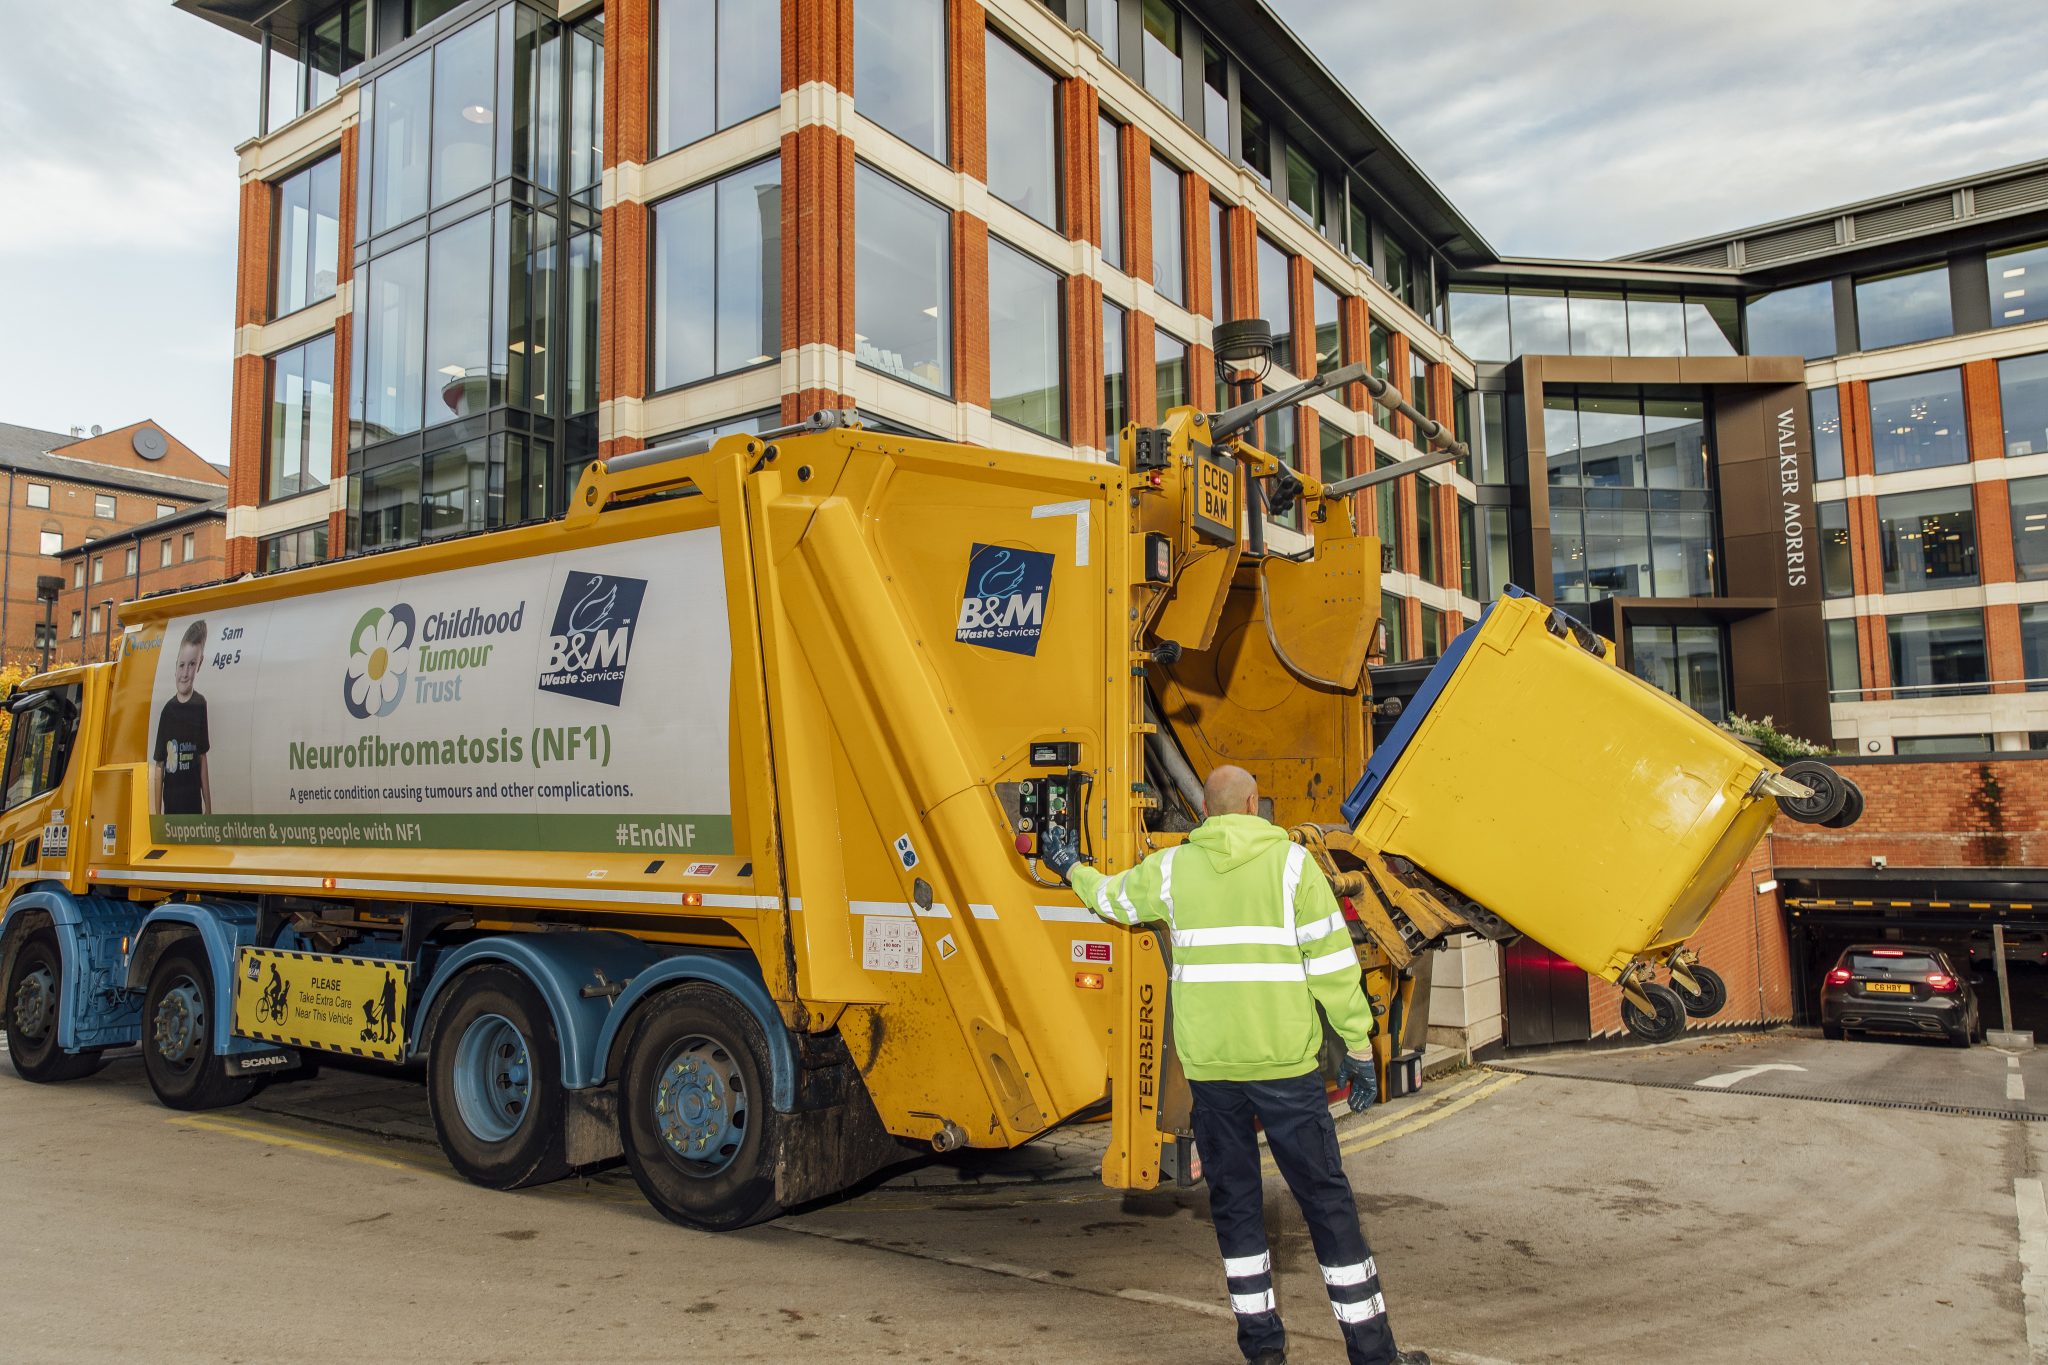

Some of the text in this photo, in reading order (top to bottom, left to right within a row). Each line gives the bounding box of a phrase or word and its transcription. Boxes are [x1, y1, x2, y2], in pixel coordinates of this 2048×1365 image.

[1203, 463, 1229, 496] CC19
[1205, 491, 1228, 521] BAM
[1777, 407, 1807, 587] WALKER MORRIS
[422, 600, 526, 642] Childhood
[957, 592, 1042, 629] B&M
[221, 626, 244, 641] Sam
[957, 627, 1040, 640] Waste Services
[212, 650, 242, 670] Age 5
[418, 644, 494, 673] Tumour
[549, 627, 629, 674] B&M
[414, 674, 463, 704] Trust
[541, 669, 625, 687] Waste Services
[289, 724, 611, 770] Neurofibromatosis (NF1)
[289, 780, 634, 804] A genetic condition causing tumours and other complications.
[165, 822, 423, 845] Supporting children & young people with NF1
[615, 822, 696, 848] #EndNF
[311, 977, 341, 991] PLEASE
[299, 991, 352, 1009] Take Extra Care
[295, 1008, 353, 1026] Near This Vehicle
[241, 1055, 288, 1069] SCANIA
[1139, 983, 1154, 1117] TERBERG
